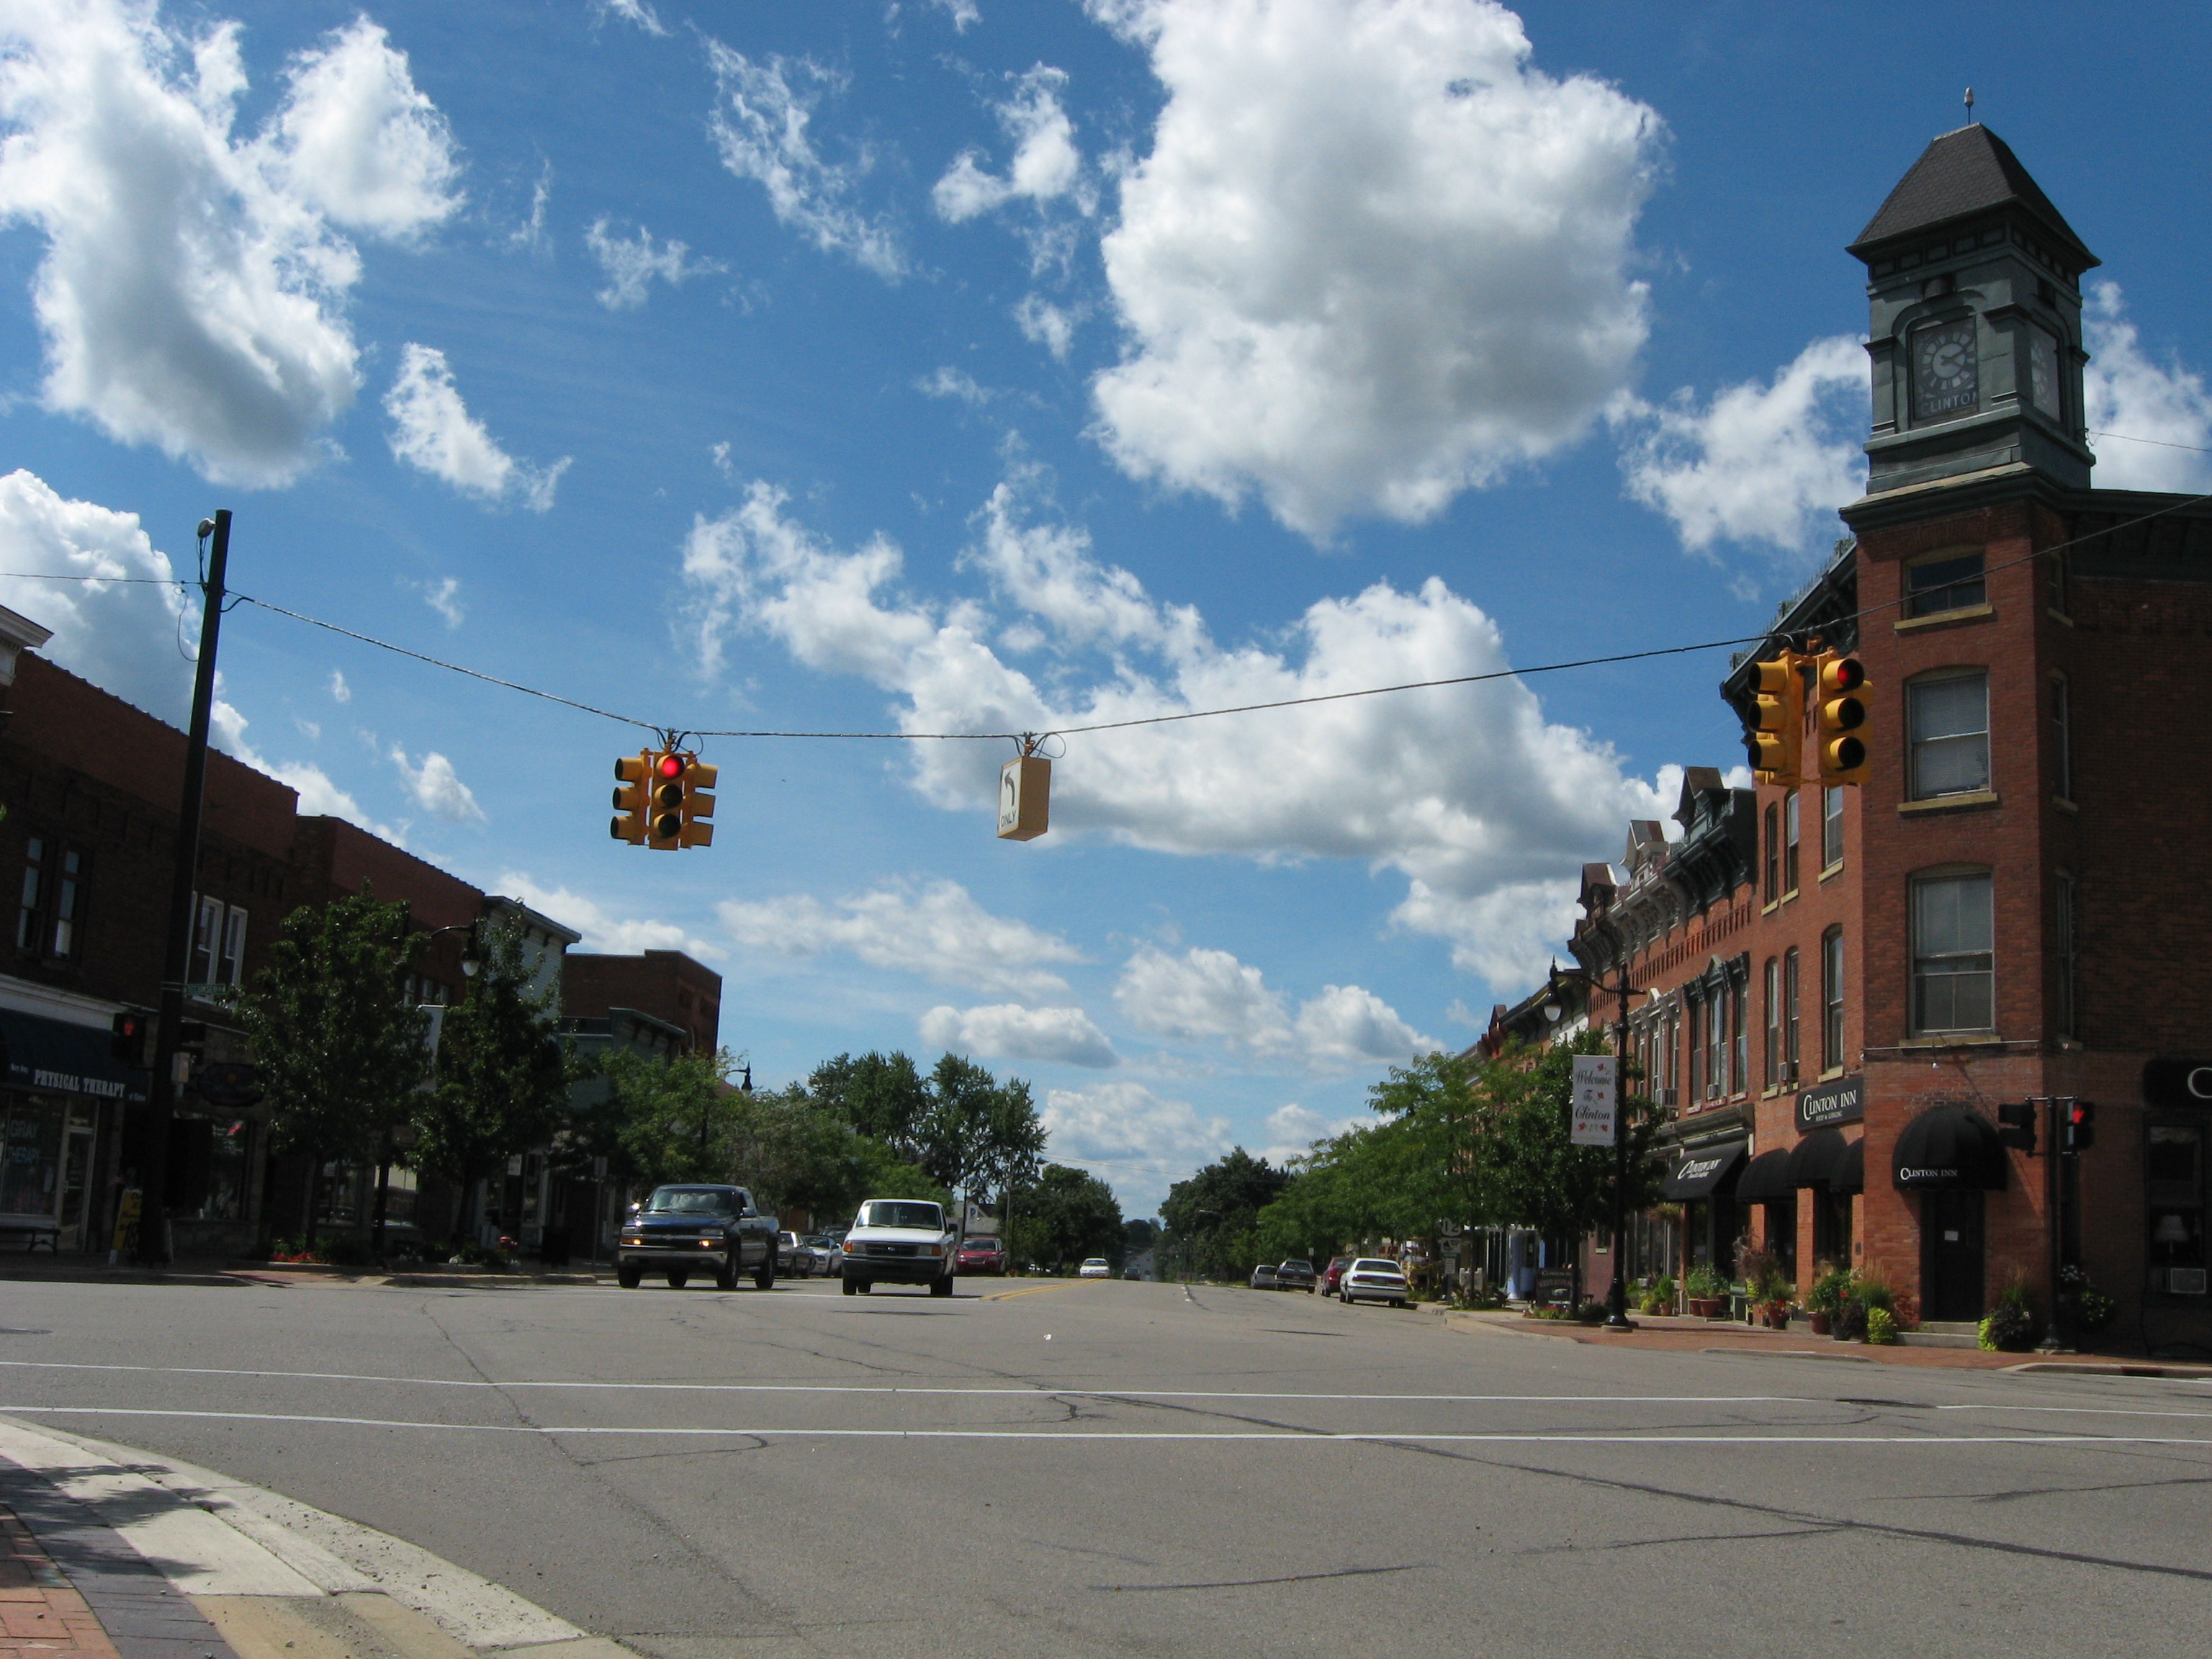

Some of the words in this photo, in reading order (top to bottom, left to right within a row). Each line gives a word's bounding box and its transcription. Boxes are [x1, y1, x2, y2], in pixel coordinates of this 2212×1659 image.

[1001, 810, 1017, 827] ONLY
[34, 1069, 80, 1092] PHYSICAL
[83, 1077, 126, 1098] THERAPY
[1576, 1070, 1611, 1085] Welcome
[1575, 1106, 1610, 1120] Clinton
[1803, 1094, 1838, 1121] CLINTON
[1840, 1089, 1857, 1108] INN
[10, 1120, 39, 1138] GRAY
[1900, 1167, 1938, 1181] CLINTON
[1941, 1169, 1958, 1177] INN
[1444, 1219, 1460, 1233] 12
